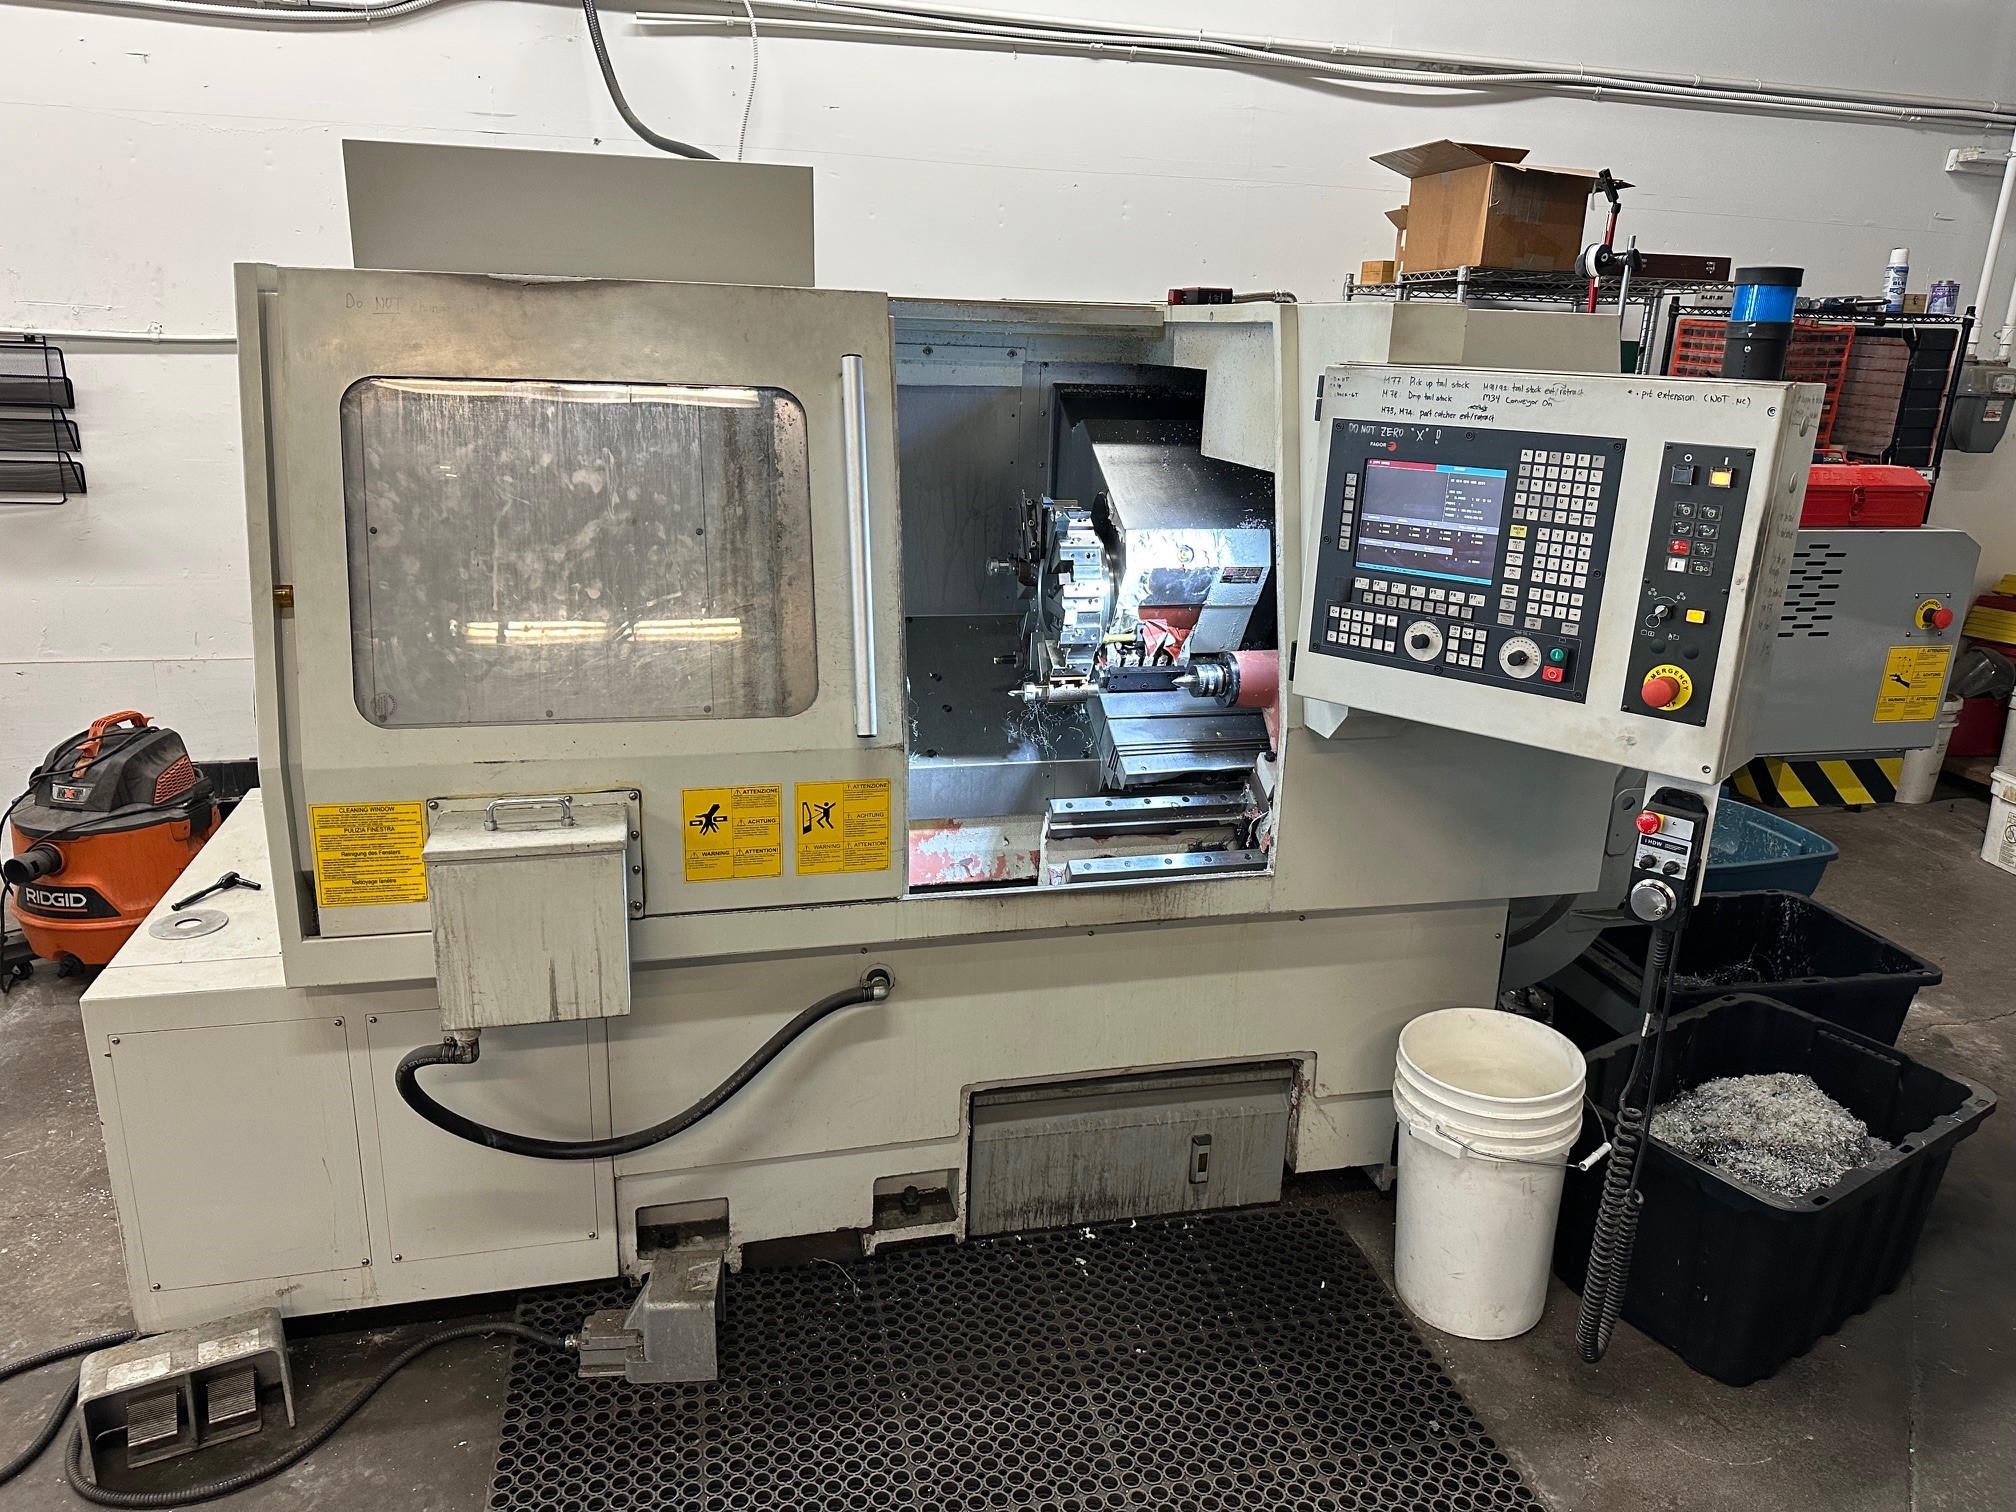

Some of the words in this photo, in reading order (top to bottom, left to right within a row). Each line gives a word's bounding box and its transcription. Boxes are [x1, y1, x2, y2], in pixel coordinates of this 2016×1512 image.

[345, 292, 363, 309] Do
[1410, 376, 1422, 386] Pick
[1436, 378, 1447, 387] tail
[1452, 380, 1470, 389] stock
[1512, 383, 1523, 392] tail
[1526, 385, 1541, 393] stock
[1424, 391, 1434, 401] tail
[1436, 393, 1452, 402] stock
[1483, 394, 1501, 403] M34
[1506, 397, 1539, 407] Conveyor
[1420, 409, 1432, 419] part
[1434, 410, 1456, 419] catcher
[1348, 423, 1358, 433] DO
[1361, 425, 1376, 435] NOT
[1381, 427, 1404, 437] ZERO
[1648, 668, 1689, 691] MERGENCY
[853, 782, 888, 790] ATTENZIONE
[25, 887, 87, 908] RIDGID
